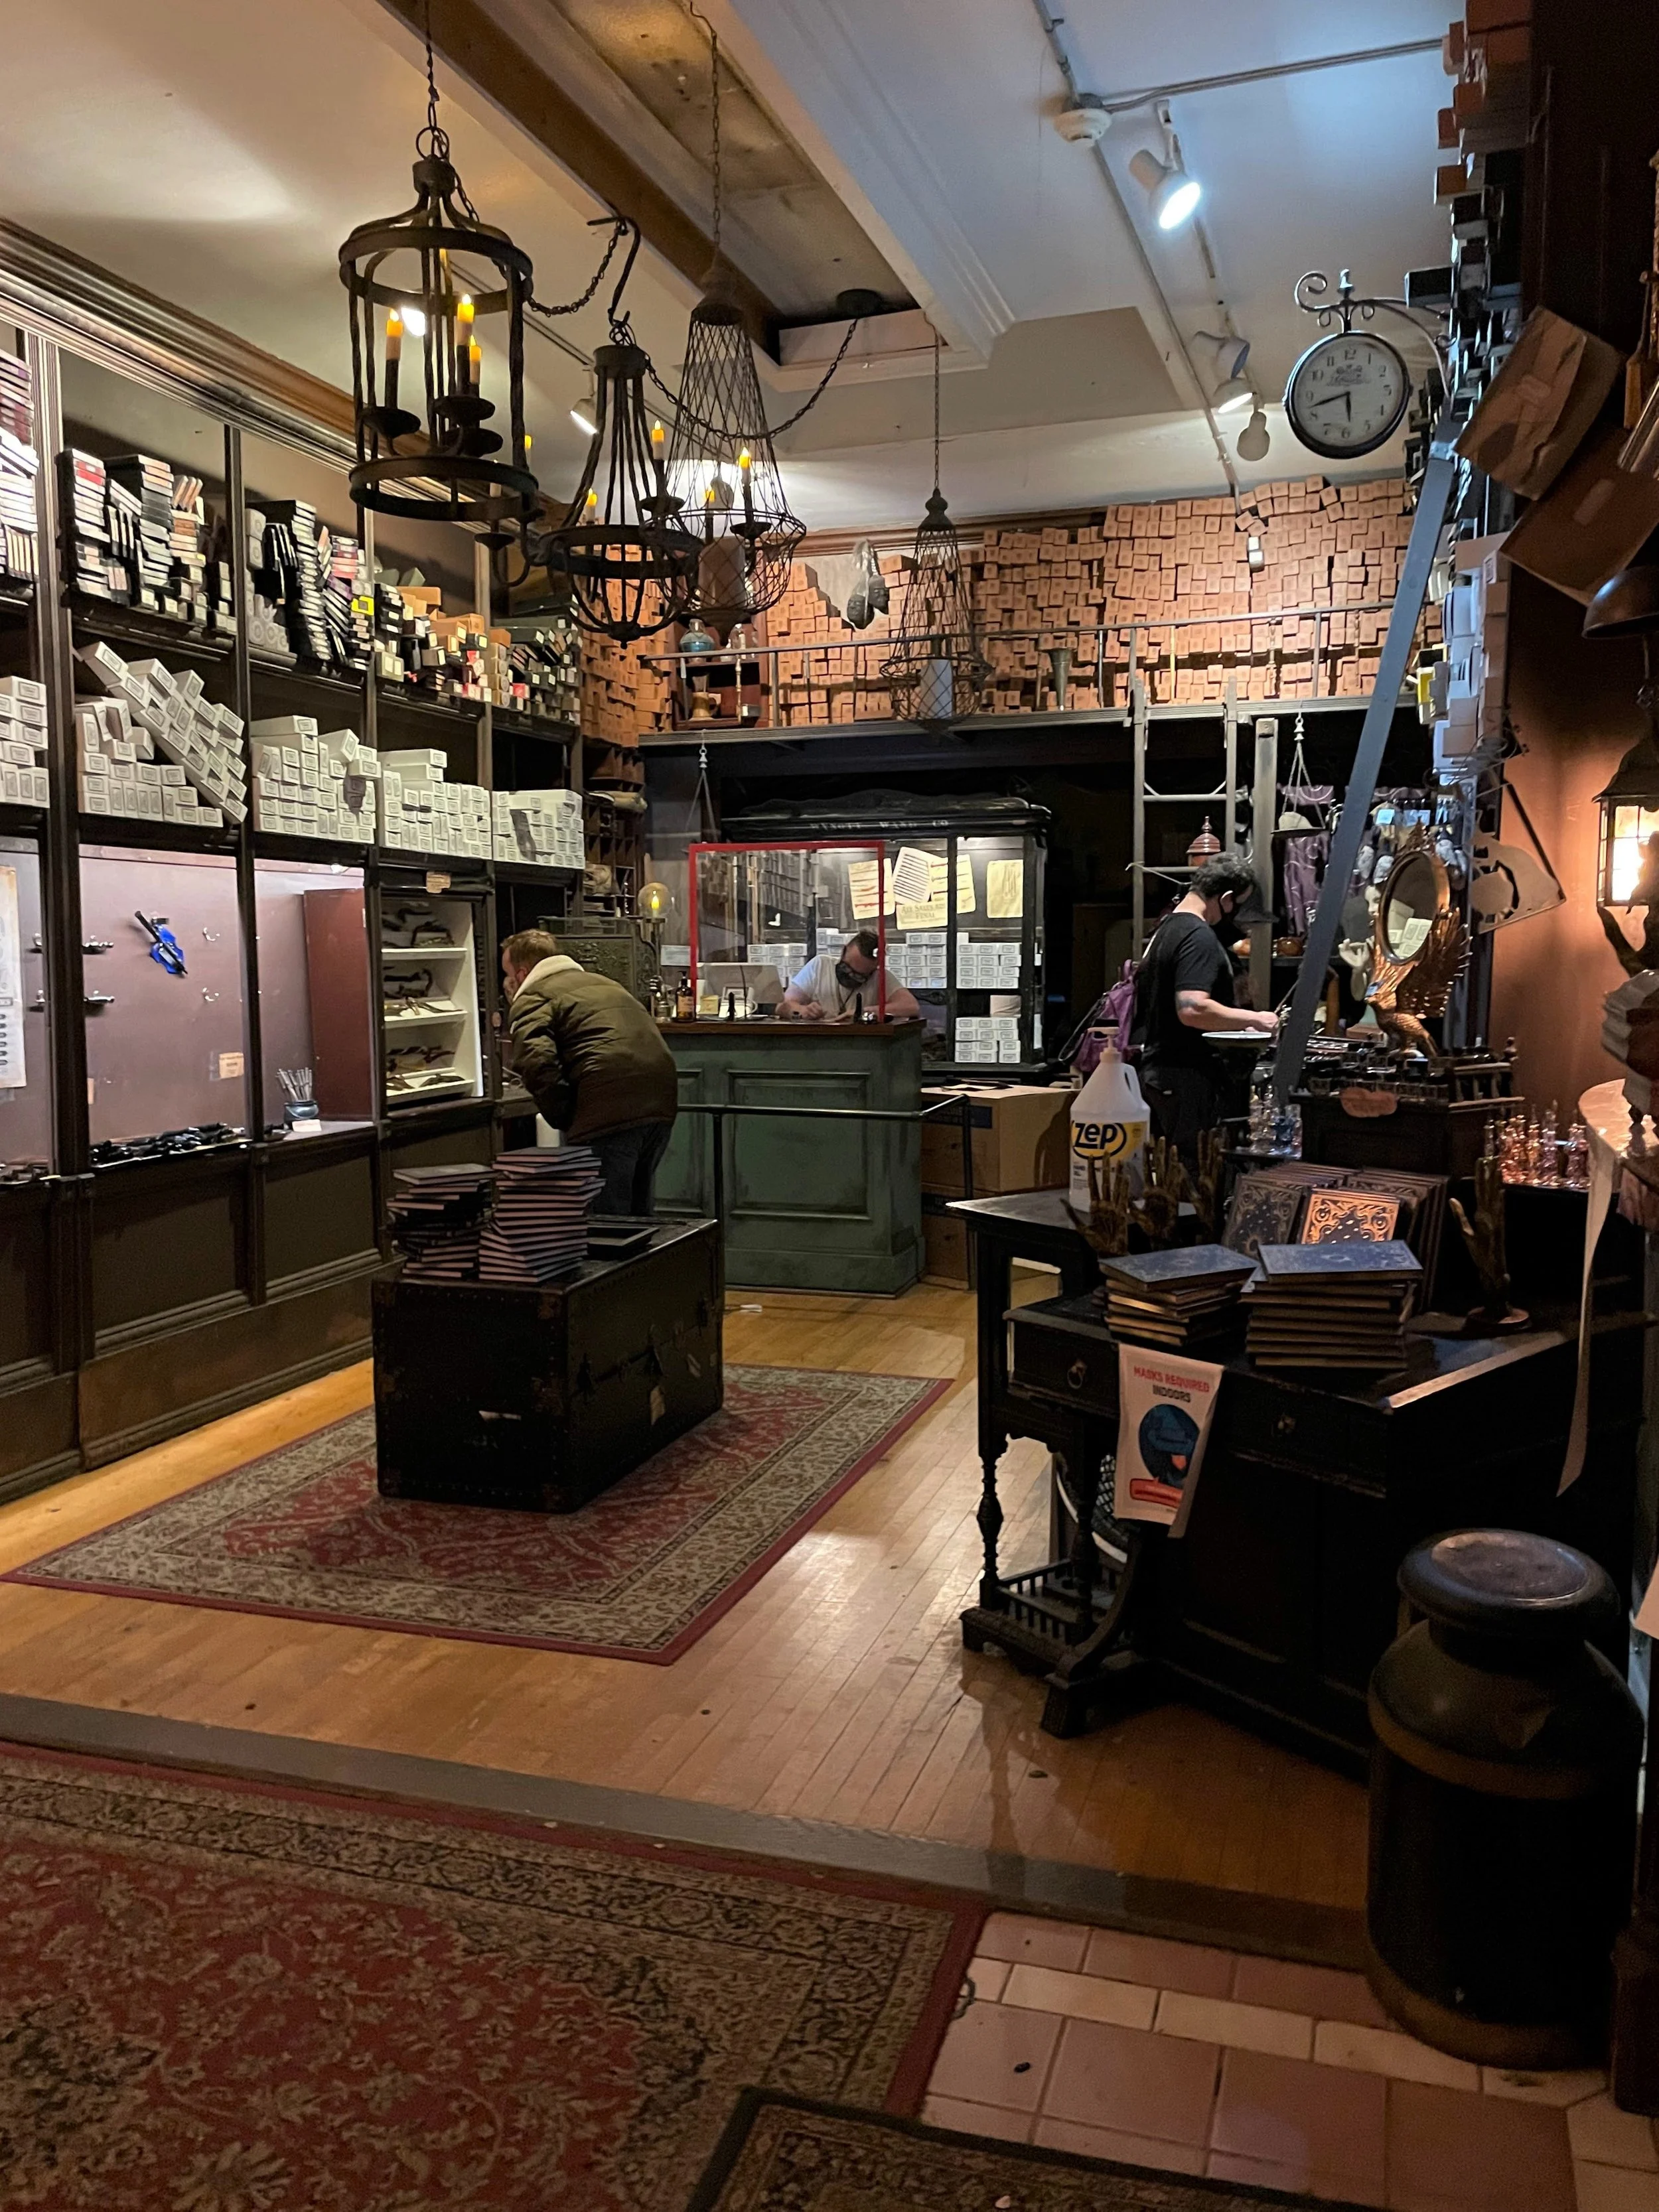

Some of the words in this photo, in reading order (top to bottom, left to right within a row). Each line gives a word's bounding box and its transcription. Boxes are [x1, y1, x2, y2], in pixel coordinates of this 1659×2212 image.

[1344, 348, 1356, 361] 12
[1327, 356, 1334, 367] 11
[1312, 370, 1324, 381] 10
[1378, 365, 1387, 378] 2
[1305, 390, 1314, 401] 9
[1323, 422, 1331, 436] 7
[1341, 426, 1350, 439] 6
[1133, 1365, 1163, 1382] MASKS
[1165, 1373, 1209, 1393] REQUIRED
[1152, 1384, 1191, 1403] INDOORS
